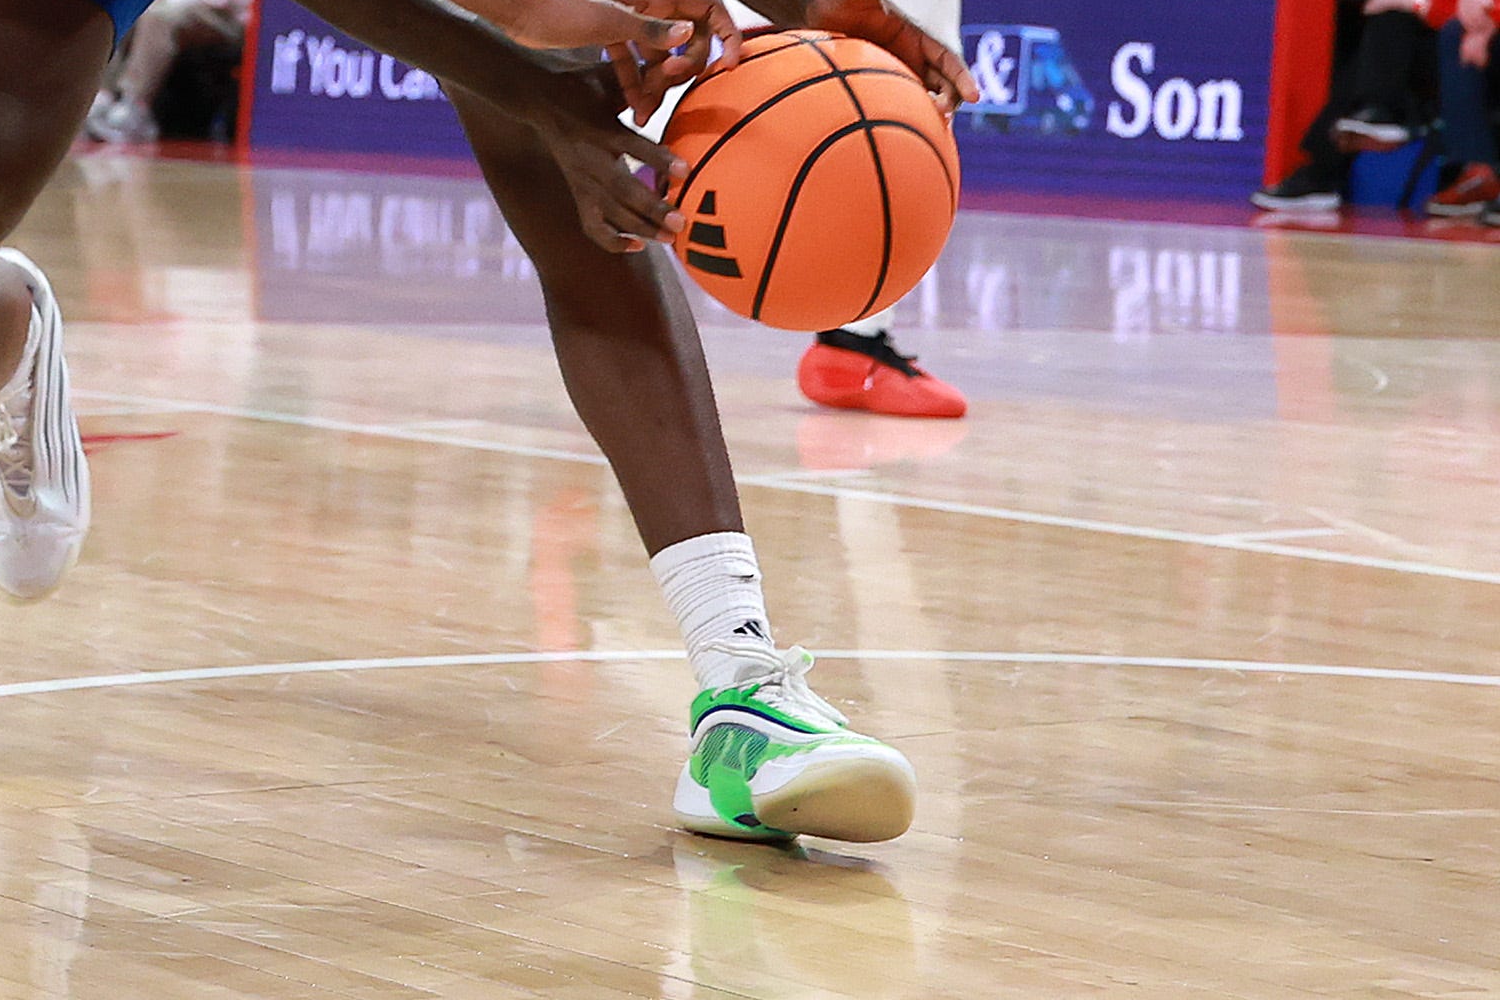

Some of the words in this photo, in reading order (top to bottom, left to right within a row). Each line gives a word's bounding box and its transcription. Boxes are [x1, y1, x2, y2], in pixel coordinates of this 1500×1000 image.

[307, 35, 375, 99] You
[380, 53, 447, 101] Ca
[973, 31, 1015, 104] &
[1106, 41, 1244, 141] Son
